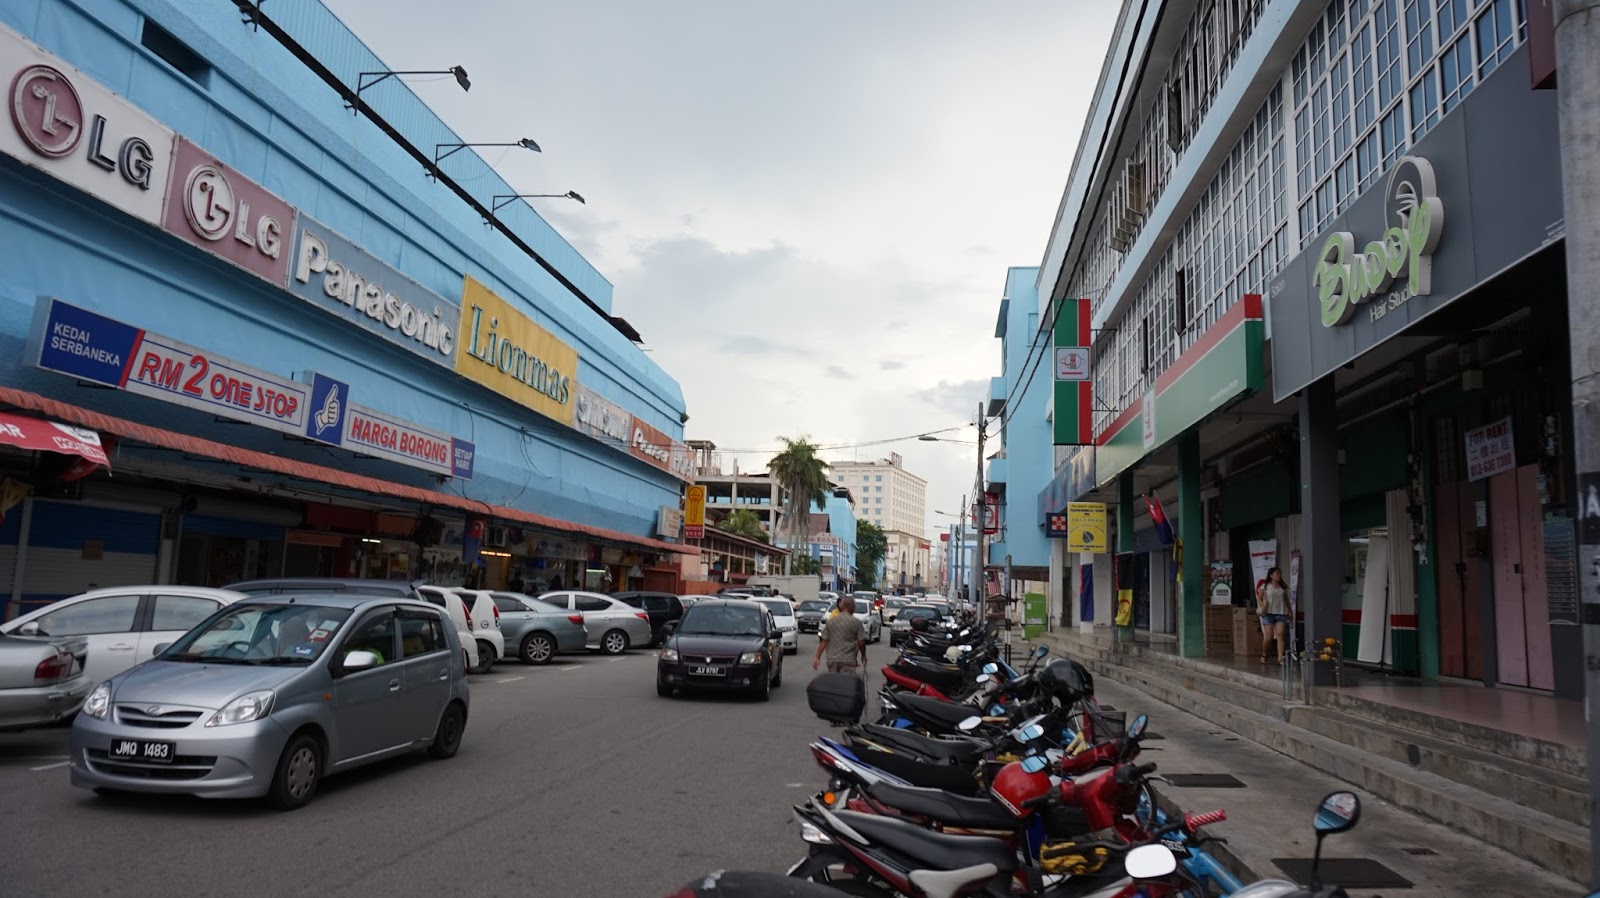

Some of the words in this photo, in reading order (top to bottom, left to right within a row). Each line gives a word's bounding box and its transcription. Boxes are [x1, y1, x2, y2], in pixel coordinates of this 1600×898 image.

[87, 114, 154, 190] LG
[235, 200, 281, 259] LG
[296, 229, 454, 355] Panasonic
[1370, 300, 1387, 323] Hair
[51, 337, 121, 367] SERBANEKA
[54, 322, 90, 344] KEDAI
[466, 303, 570, 405] Lionmas
[138, 351, 184, 390] RM
[182, 354, 210, 397] 2
[253, 386, 299, 418] STOP
[351, 416, 397, 450] HARGA
[400, 432, 448, 463] BORONG
[1469, 430, 1485, 447] FOR
[1487, 422, 1507, 440] RENT
[115, 741, 138, 755] JMQ
[144, 743, 169, 758] 1483
